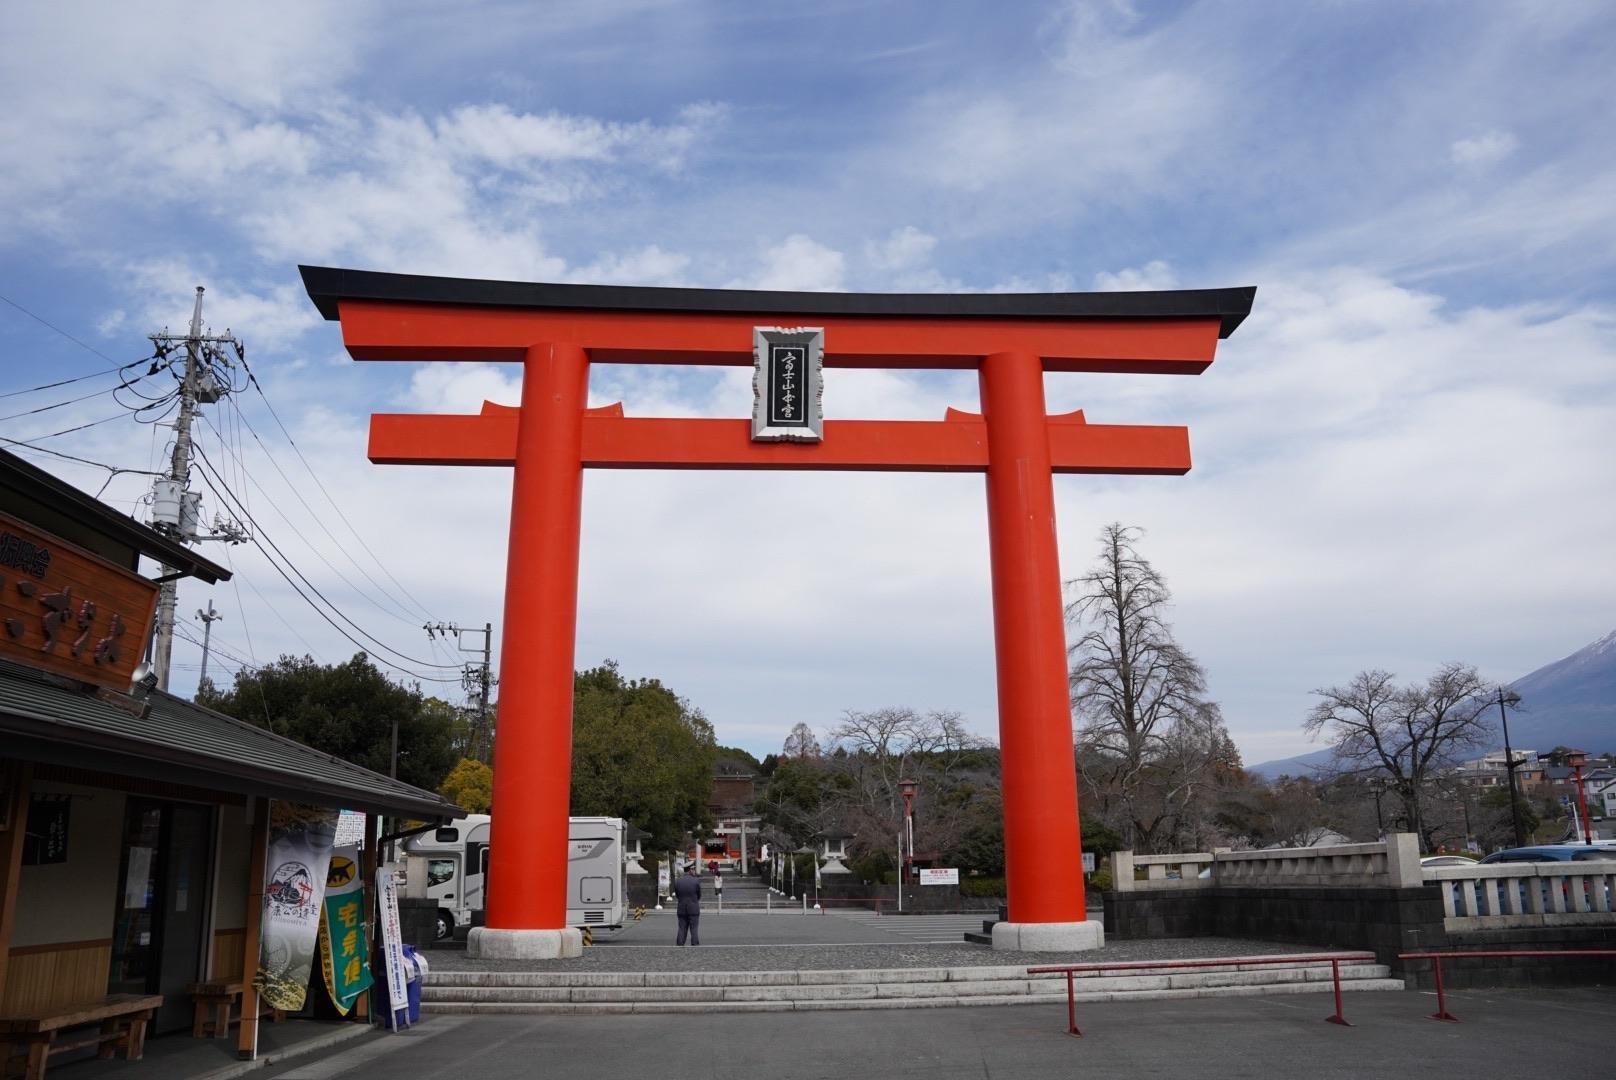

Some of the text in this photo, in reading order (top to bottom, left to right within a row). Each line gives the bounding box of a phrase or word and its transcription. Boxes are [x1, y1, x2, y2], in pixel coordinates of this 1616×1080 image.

[781, 351, 796, 418] 富士山本宮
[337, 902, 361, 987] 宅急便
